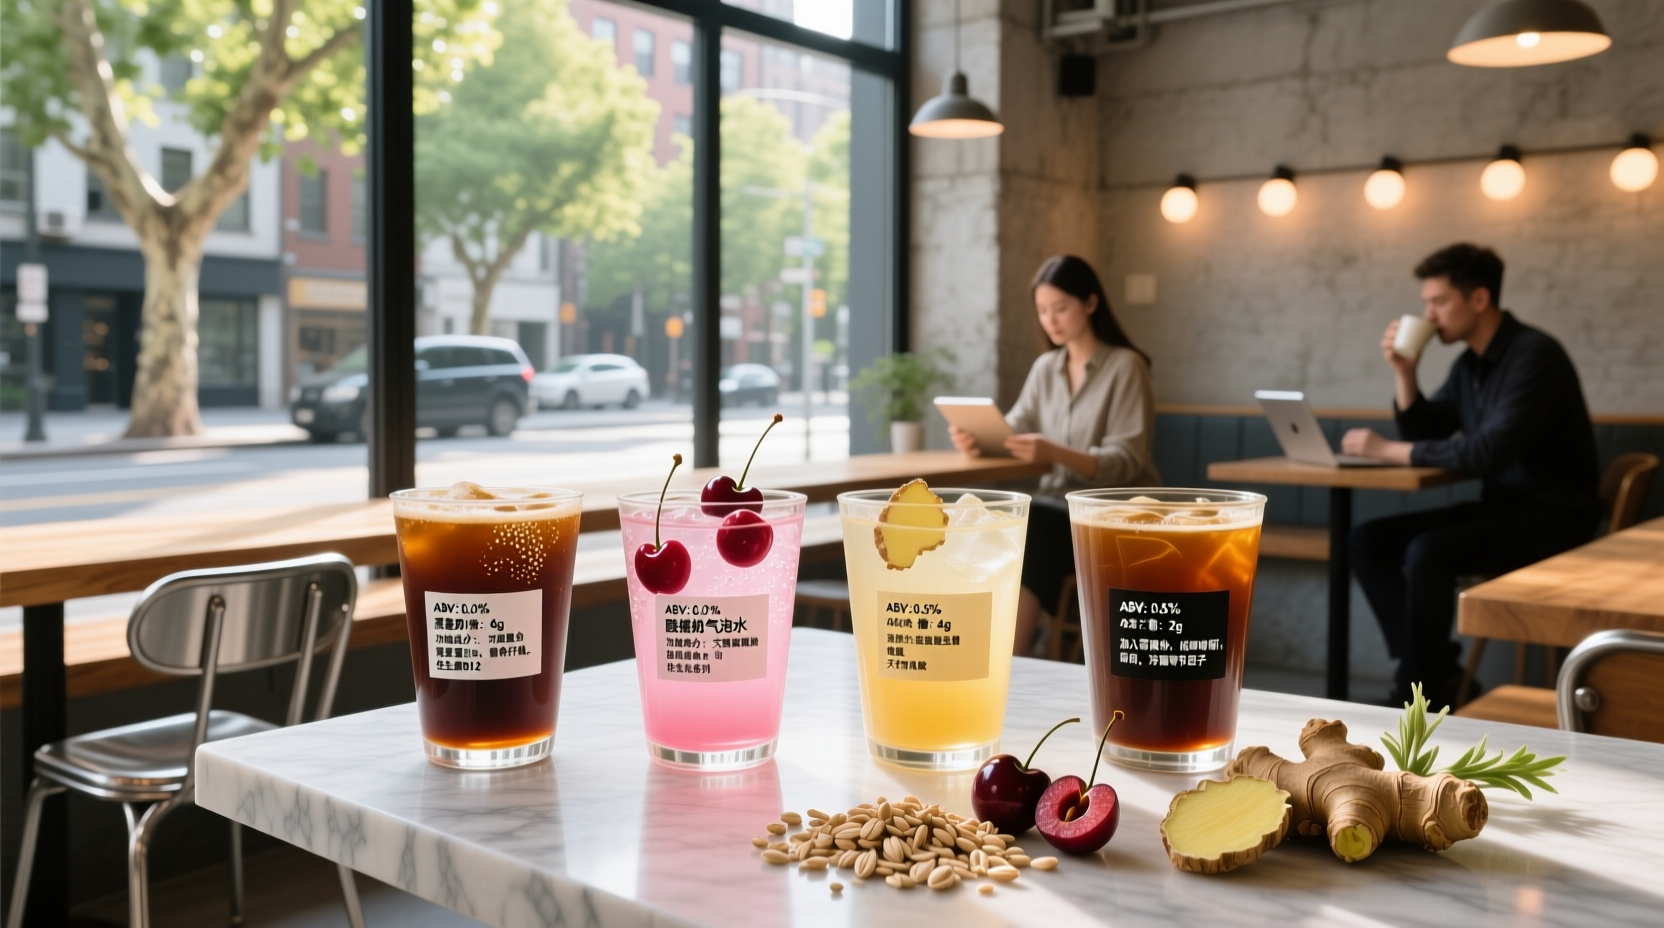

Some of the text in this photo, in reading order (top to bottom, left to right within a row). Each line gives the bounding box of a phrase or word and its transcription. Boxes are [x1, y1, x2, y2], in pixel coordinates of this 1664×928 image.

[490, 618, 504, 631] 6g
[937, 619, 952, 633] 4g
[1168, 620, 1183, 634] 2g
